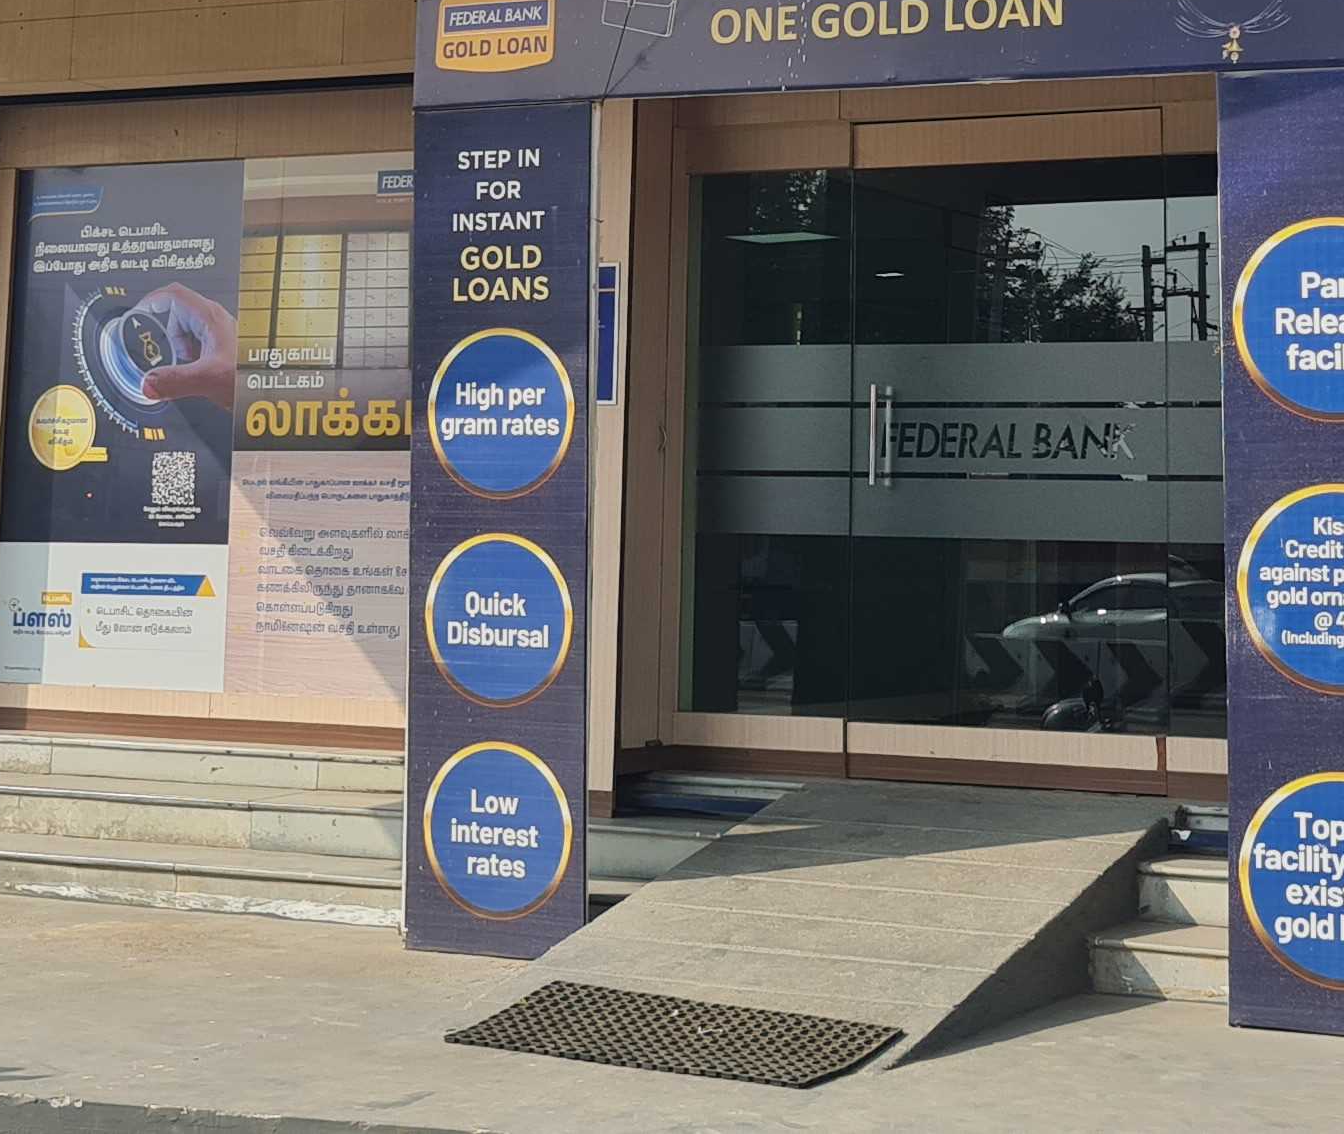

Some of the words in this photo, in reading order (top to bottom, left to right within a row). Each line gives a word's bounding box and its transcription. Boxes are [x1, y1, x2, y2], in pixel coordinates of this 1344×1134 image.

[449, 9, 502, 27] FEDERAL
[504, 6, 542, 23] BANK
[710, 5, 798, 45] ONE
[443, 39, 491, 59] GOLD
[497, 35, 547, 55] LOAN
[457, 149, 511, 170] STEP
[518, 148, 541, 167] IN
[475, 180, 521, 201] FOR
[452, 210, 545, 232] INSTANT
[460, 244, 542, 271] GOLD
[453, 275, 550, 303] LOANS
[248, 343, 335, 368] பாதுகாப்பு
[247, 371, 324, 389] பெட்டகம்
[455, 382, 506, 411] High
[508, 385, 546, 411] per
[440, 415, 499, 441] gram
[501, 413, 560, 437] rates
[880, 422, 1022, 459] FEDERAL
[1032, 422, 1136, 460] BANK
[1285, 539, 1344, 559] Credit
[1259, 564, 1330, 585] against
[464, 591, 527, 619] Quick
[1267, 587, 1308, 609] gold
[447, 621, 550, 650] Disbursal
[1281, 630, 1344, 648] (including
[470, 788, 519, 816] Low
[450, 818, 539, 849] interest
[466, 853, 526, 879] rates
[1274, 912, 1335, 945] gold
